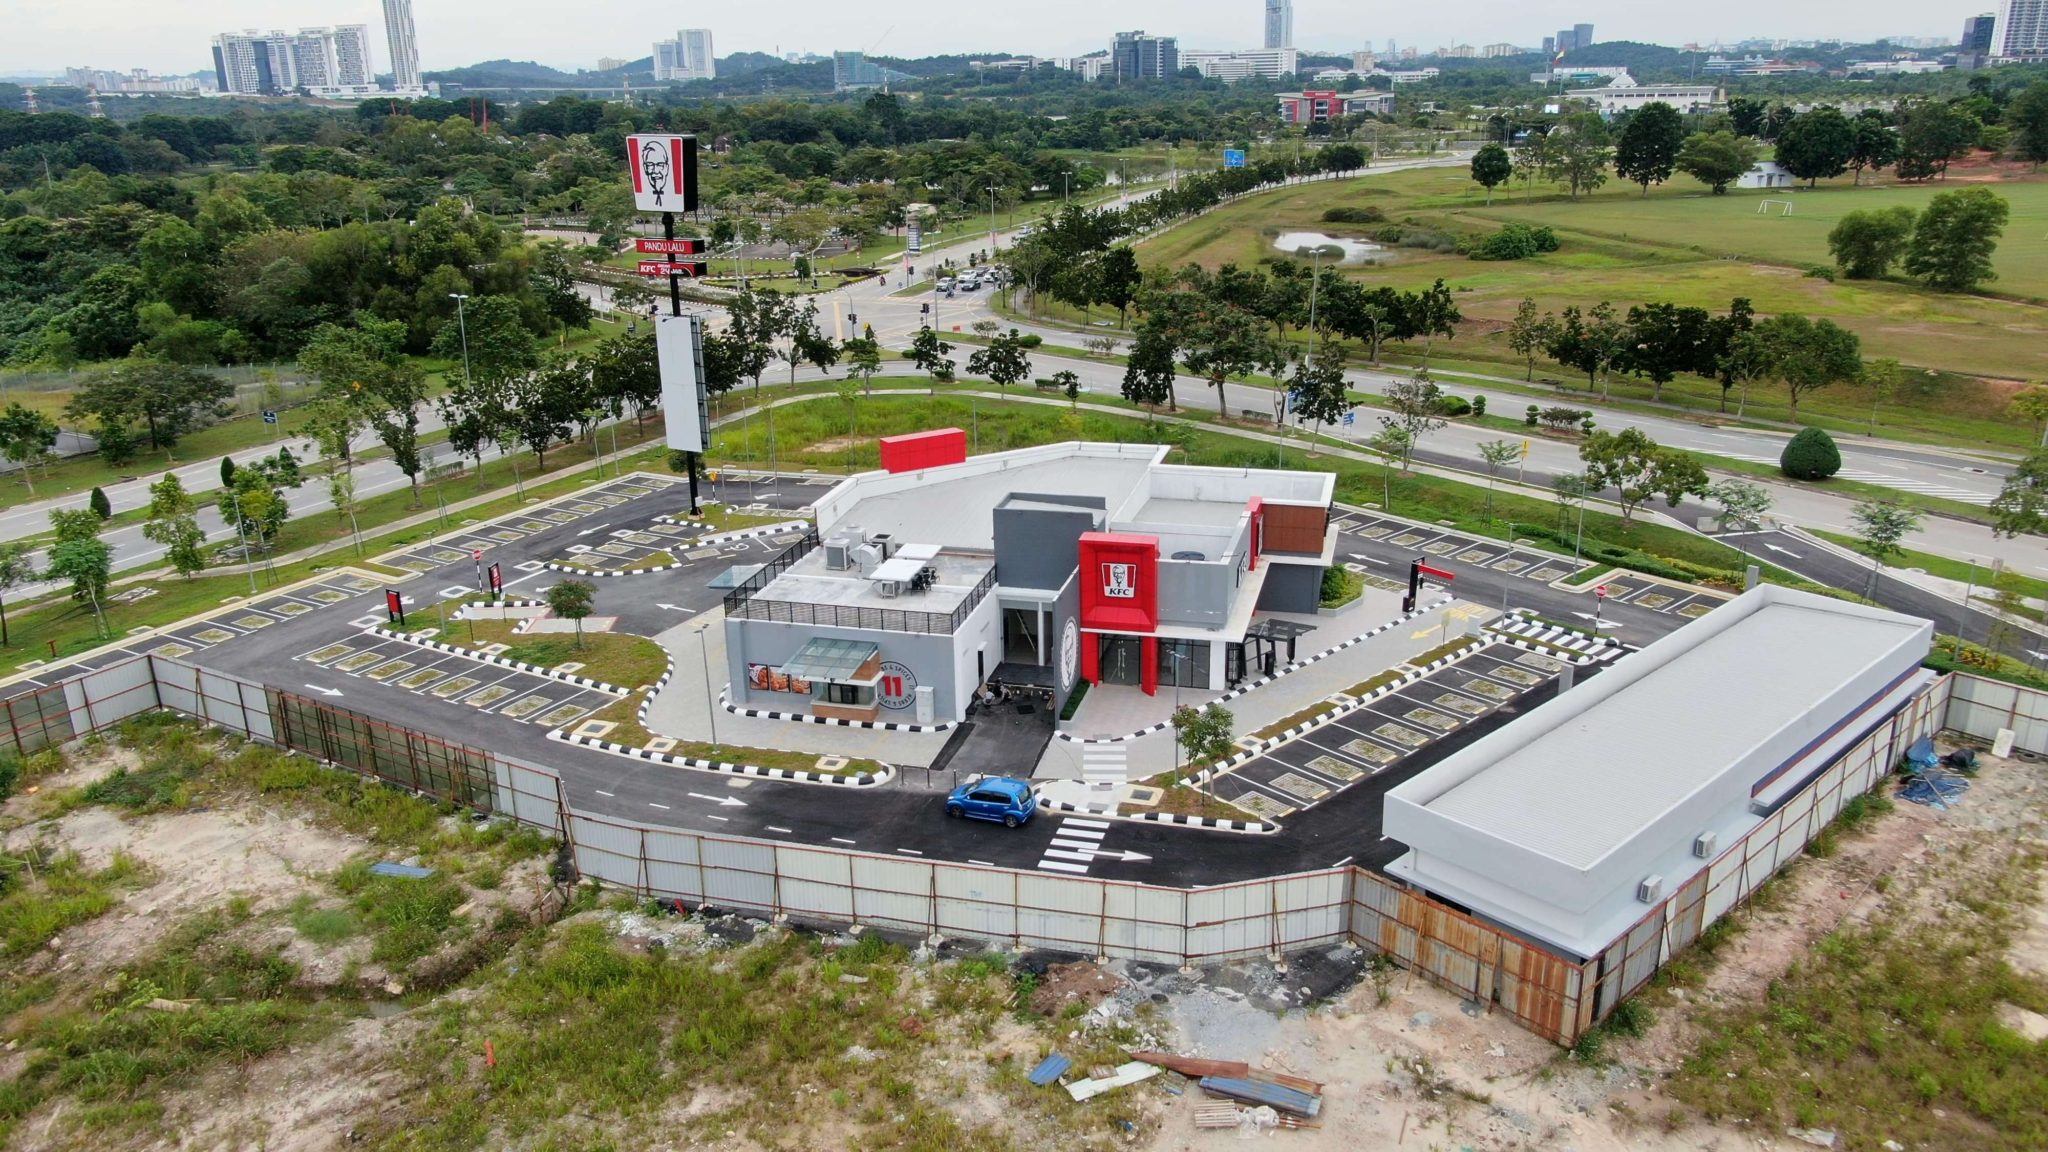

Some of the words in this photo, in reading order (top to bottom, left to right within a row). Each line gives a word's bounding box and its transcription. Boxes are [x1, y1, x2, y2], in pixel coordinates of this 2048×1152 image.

[644, 241, 666, 251] PANDU
[668, 242, 684, 252] LALU
[640, 265, 656, 273] KFC
[660, 267, 670, 275] 24
[1109, 588, 1130, 596] KFC
[882, 675, 902, 697] 11
